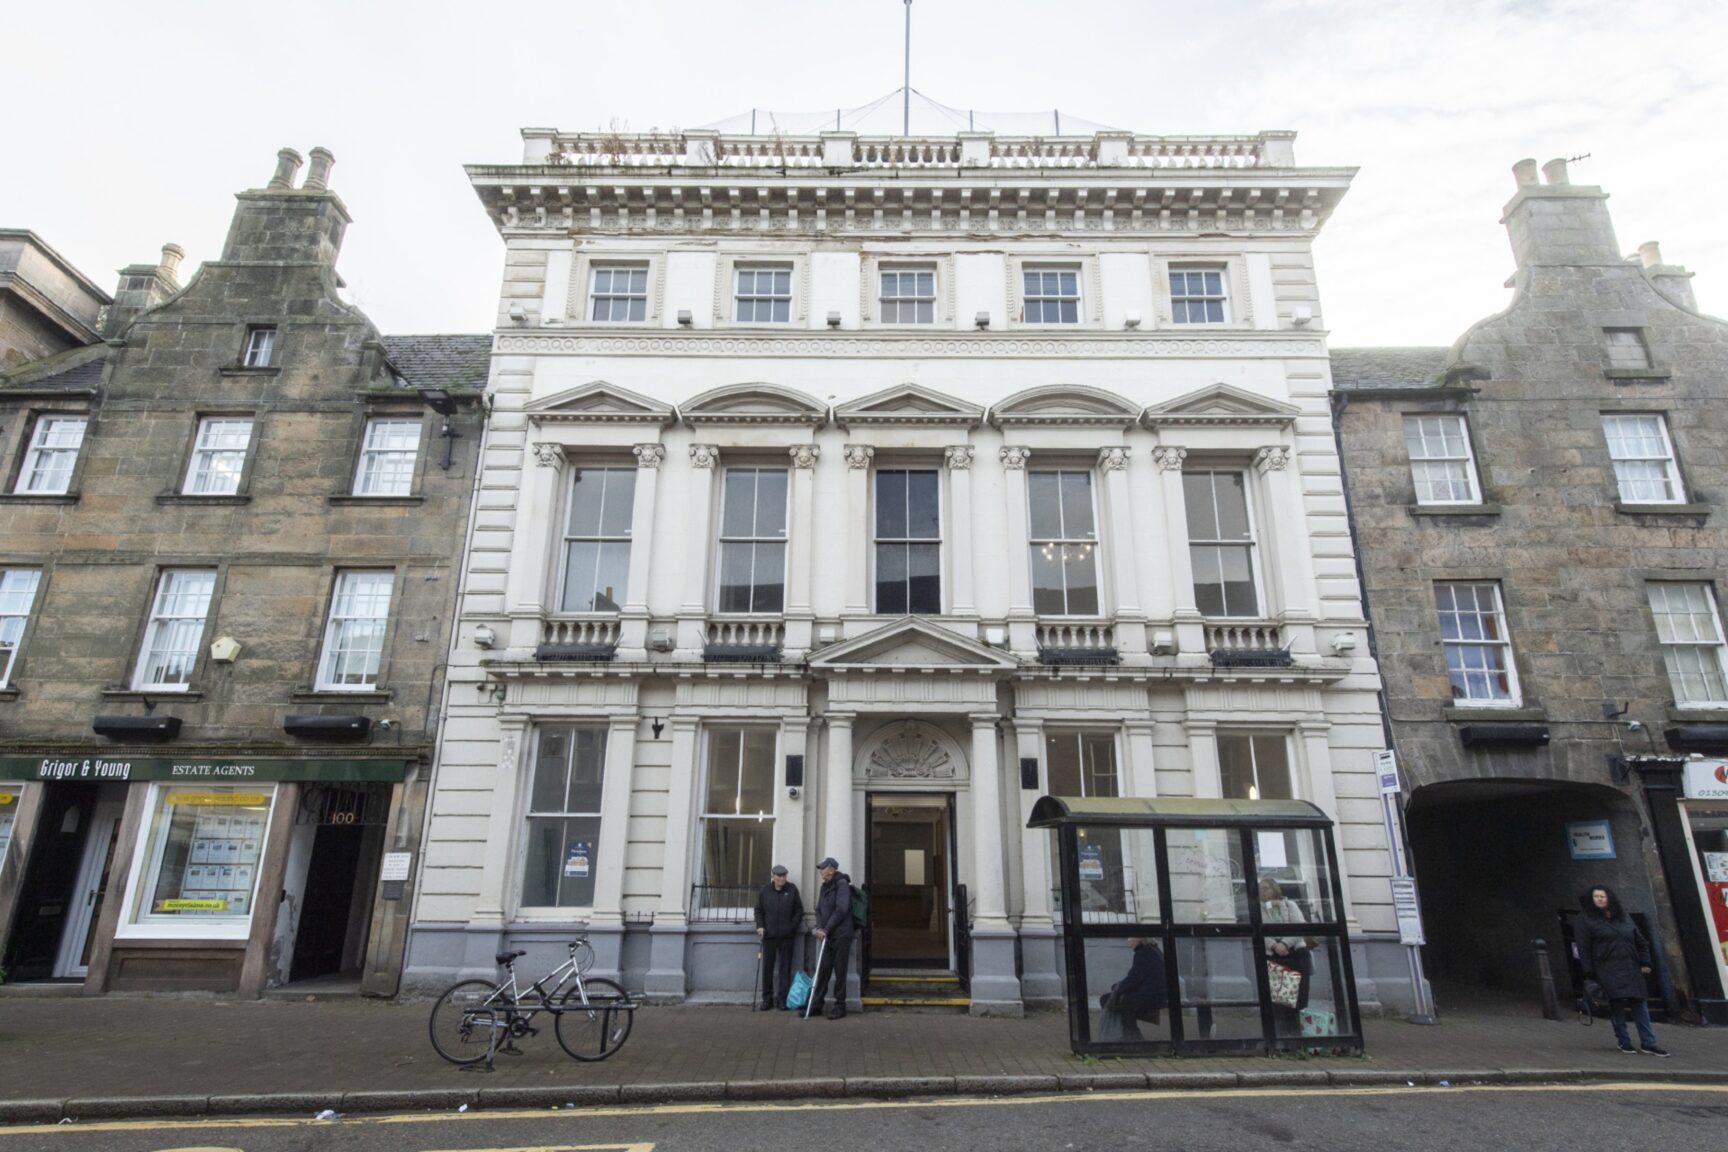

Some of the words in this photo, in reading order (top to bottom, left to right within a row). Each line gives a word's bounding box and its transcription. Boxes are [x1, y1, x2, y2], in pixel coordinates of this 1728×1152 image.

[40, 759, 79, 779] Grigor
[81, 759, 91, 777] &
[95, 759, 131, 780] Young
[172, 765, 212, 775] ESTATE
[213, 765, 255, 776] AGENTS
[332, 812, 354, 825] 100
